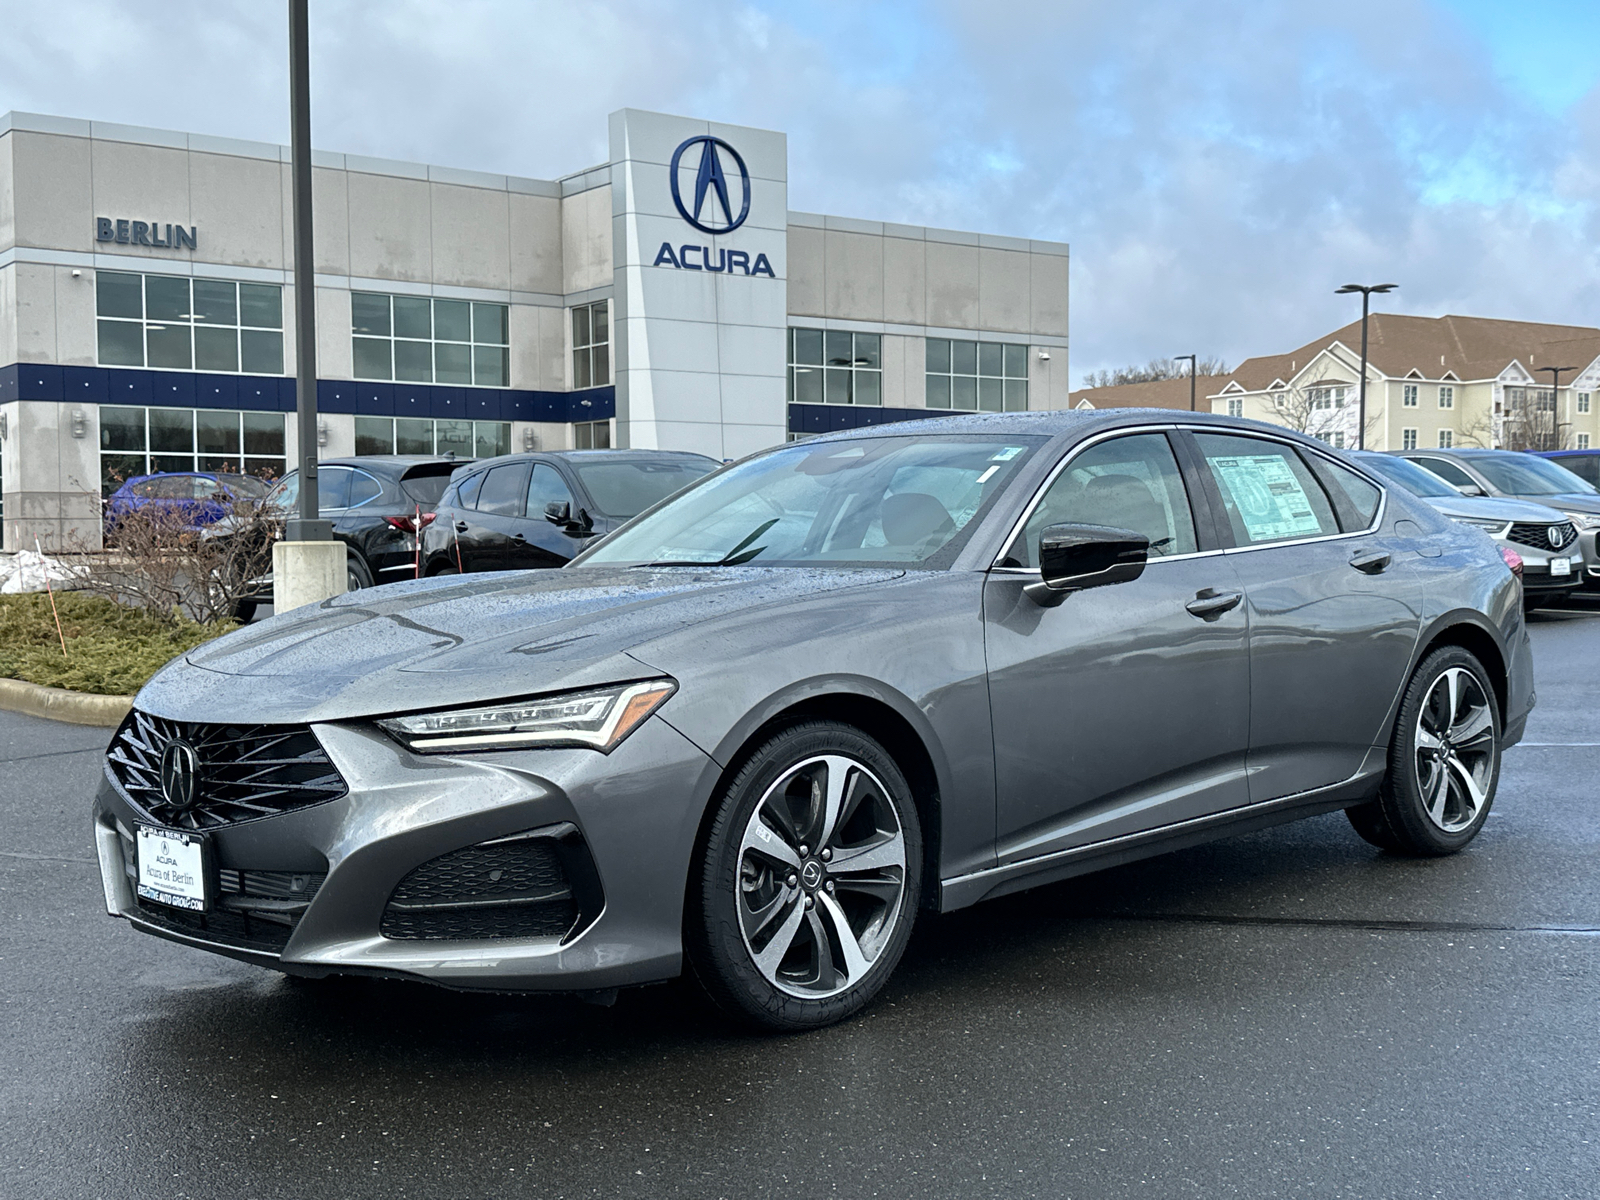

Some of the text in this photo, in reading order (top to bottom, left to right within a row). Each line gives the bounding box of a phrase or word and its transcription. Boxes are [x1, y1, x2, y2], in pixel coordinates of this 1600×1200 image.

[96, 217, 198, 250] BERLIN
[653, 242, 776, 278] ACURA
[166, 831, 190, 842] BERLIN
[156, 856, 178, 866] ACURA
[146, 864, 194, 885] Acura of Berlin
[159, 893, 171, 904] AUTO
